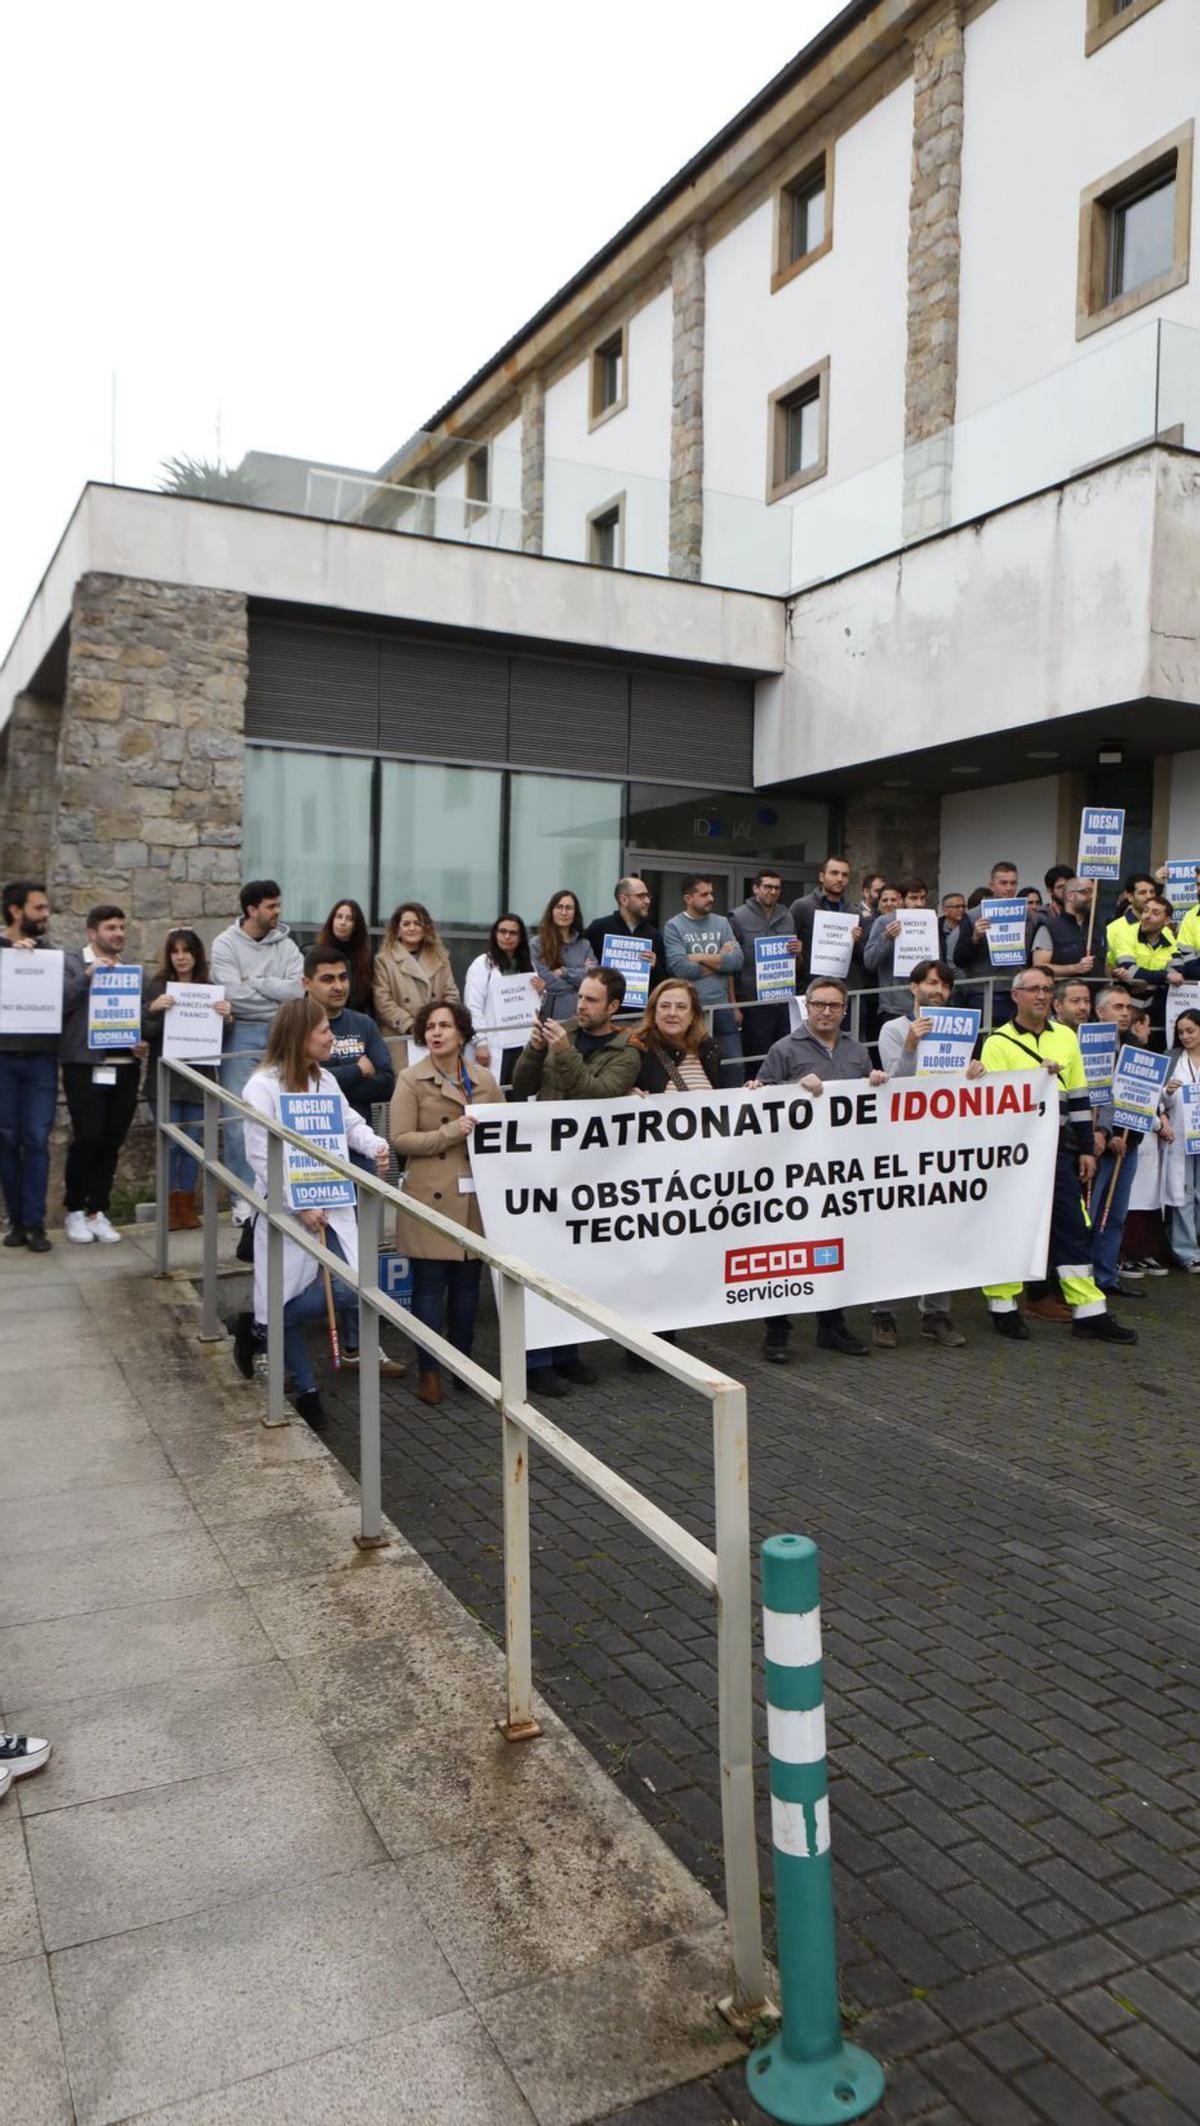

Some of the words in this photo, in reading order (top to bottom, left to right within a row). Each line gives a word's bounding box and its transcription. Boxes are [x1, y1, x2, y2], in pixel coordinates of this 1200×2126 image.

[1088, 814, 1119, 830] IDESA
[1097, 836, 1107, 845] NO
[1085, 845, 1117, 856] BLOQUEES
[1082, 864, 1116, 877] IDONIAL
[1168, 865, 1197, 879] PRAS
[1171, 892, 1198, 902] BLOQU
[998, 924, 1009, 933] NO
[107, 996, 119, 1007] NO
[94, 1008, 135, 1020] BLOQUEES
[93, 1030, 138, 1043] IDONIAL
[938, 1042, 952, 1054] NO
[922, 1055, 966, 1069] BLOQUEES
[1089, 1088, 1110, 1101] ONIAL
[288, 1099, 335, 1115] ARCELOR
[294, 1116, 333, 1131] MITTAL
[473, 1120, 532, 1155] EL
[551, 1099, 814, 1152] PATRONATO
[829, 1094, 878, 1128] DE
[890, 1084, 1047, 1122] IDONIAL,
[1114, 1110, 1149, 1126] DONIAL
[329, 1137, 340, 1150] AL
[505, 1187, 558, 1216] UN
[571, 1169, 775, 1211] OBSTÁCULO
[785, 1158, 865, 1189] PARA
[874, 1154, 909, 1180] EL
[919, 1142, 1029, 1176] FUTURO
[296, 1185, 350, 1200] IDONIAL
[565, 1195, 809, 1245] TECNOLÓGICO
[820, 1177, 988, 1219] ASTURIANO
[730, 1247, 808, 1277] CCOO
[387, 1258, 409, 1291] P
[726, 1279, 814, 1304] servicios
